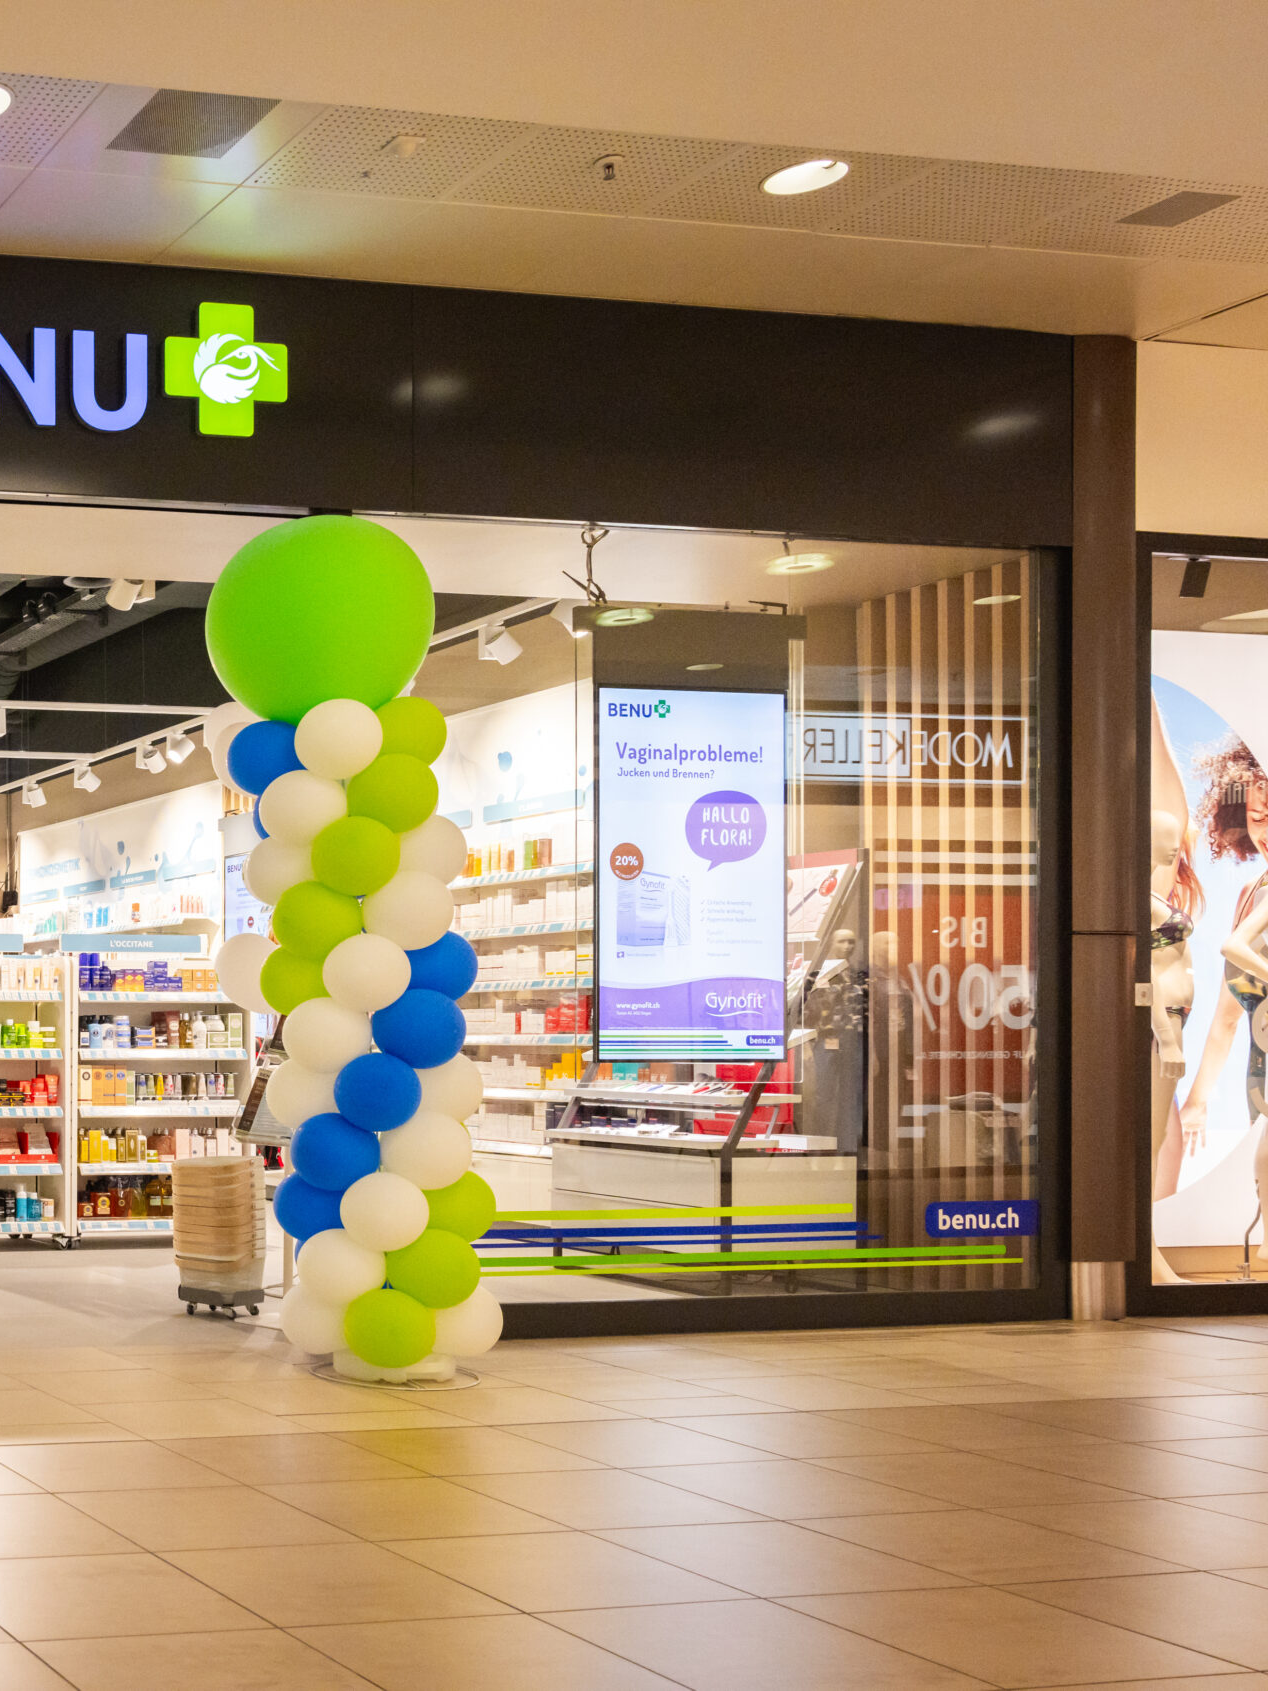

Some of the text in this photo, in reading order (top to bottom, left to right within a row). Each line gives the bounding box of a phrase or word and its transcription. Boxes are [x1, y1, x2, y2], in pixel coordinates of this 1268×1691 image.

[608, 703, 653, 718] BENU
[615, 741, 763, 765] Vaginalprobleme!
[617, 767, 715, 779] Jucken und Brennen?
[702, 806, 750, 823] HALLO
[701, 828, 752, 847] FLORA!
[614, 855, 639, 866] 20%
[109, 939, 154, 948] L'OCCITANE
[616, 1002, 661, 1010] www.gynofit.ch
[749, 1036, 776, 1045] benu.ch
[938, 1206, 1020, 1231] benu.ch
